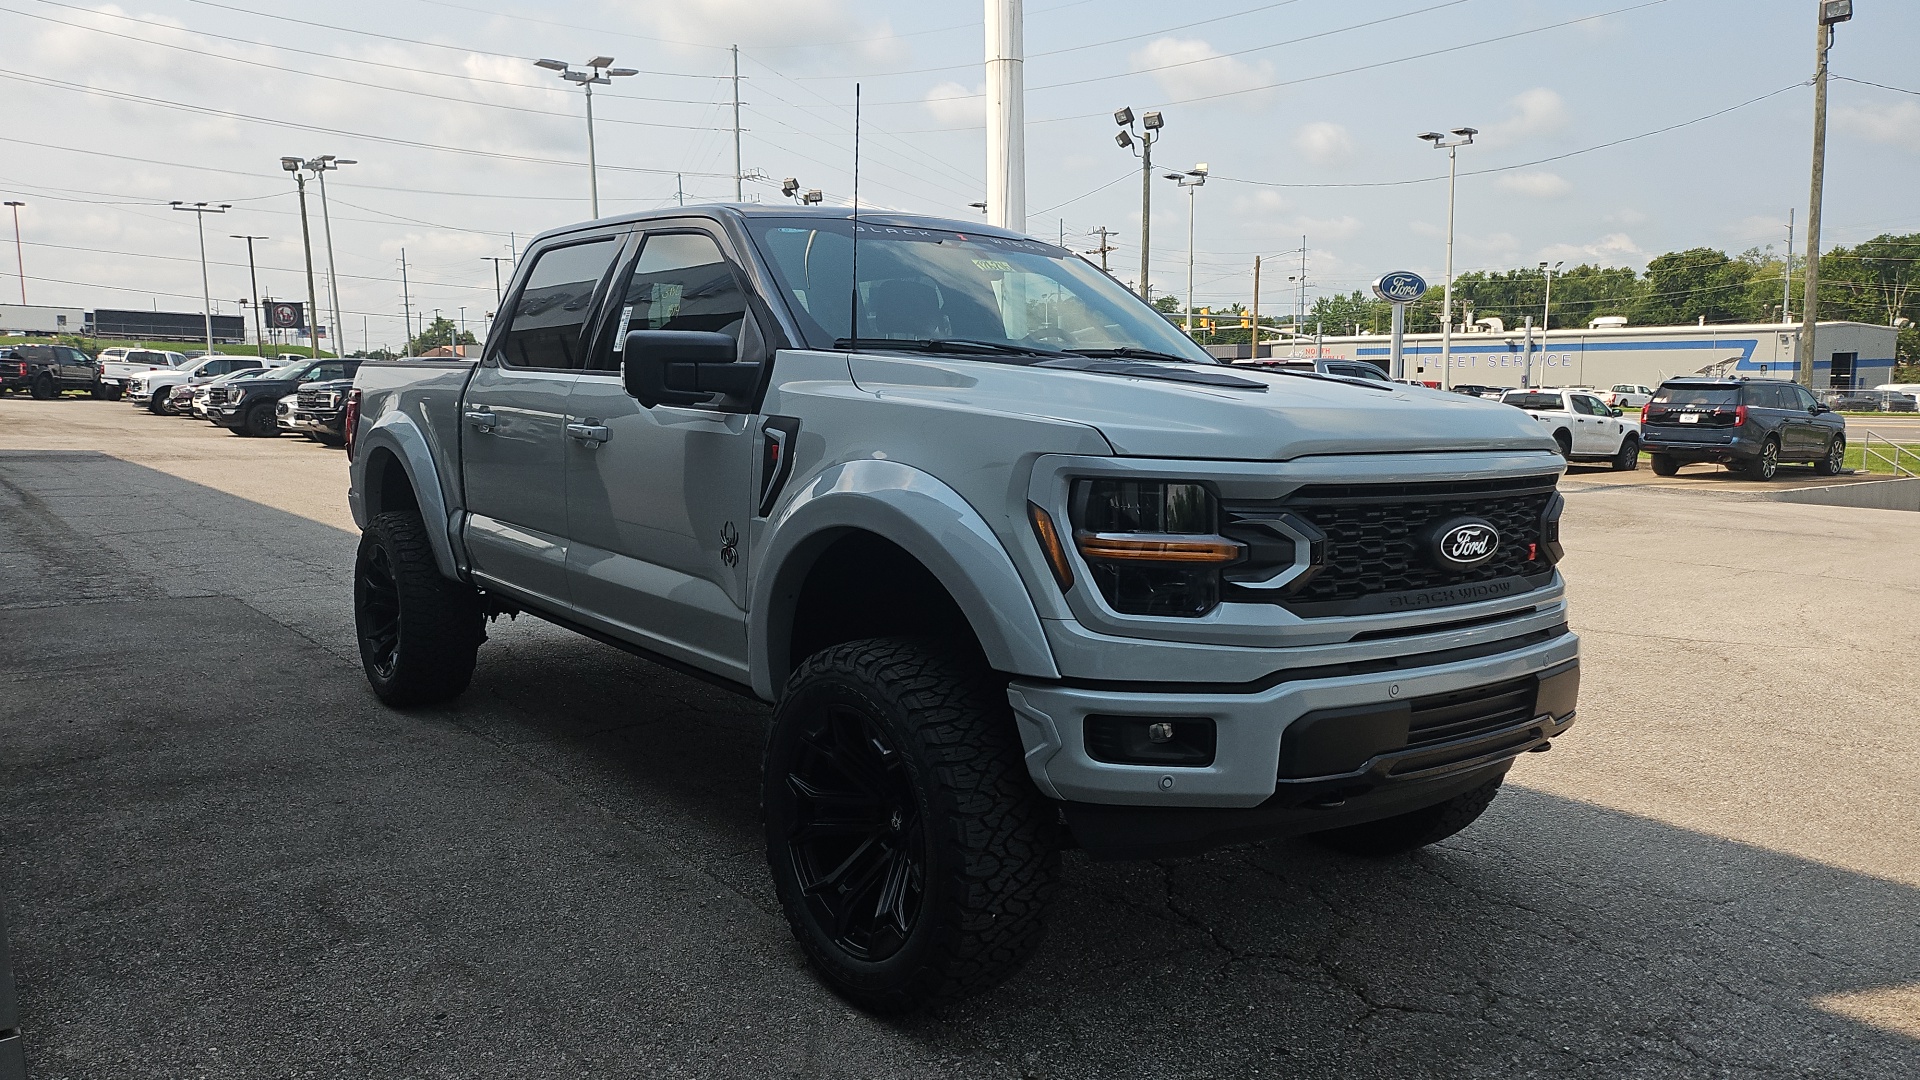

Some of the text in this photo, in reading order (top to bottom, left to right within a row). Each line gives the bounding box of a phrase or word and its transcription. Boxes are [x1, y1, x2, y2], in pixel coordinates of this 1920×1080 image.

[852, 226, 931, 237] BLACK
[1389, 276, 1419, 296] Ford
[1423, 355, 1478, 368] FLEET
[1452, 529, 1490, 557] Ford
[1389, 581, 1511, 606] BLACK WIDOW
